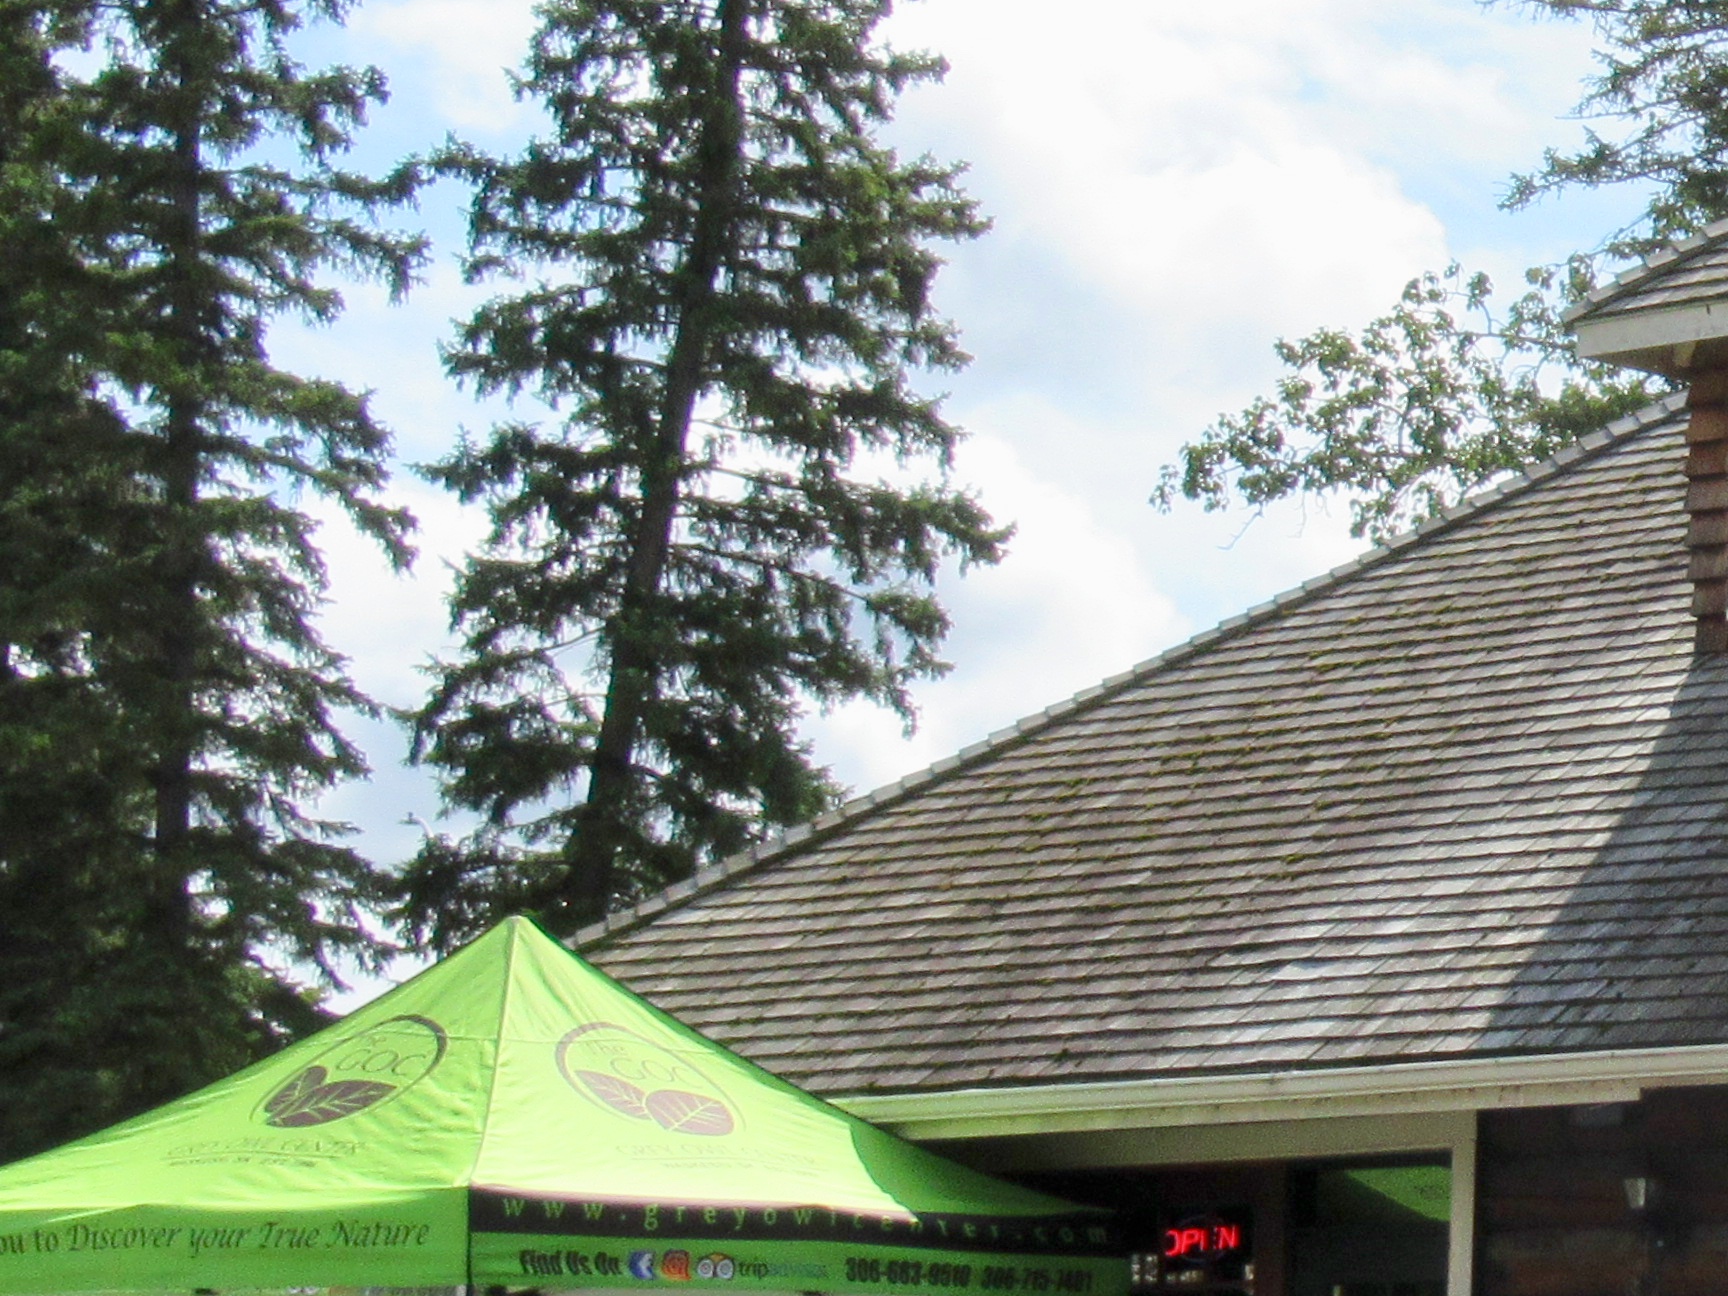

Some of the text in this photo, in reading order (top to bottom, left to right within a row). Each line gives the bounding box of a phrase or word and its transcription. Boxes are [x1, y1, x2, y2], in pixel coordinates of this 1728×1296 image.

[336, 1049, 428, 1077] GOC
[34, 1228, 60, 1252] to
[68, 1223, 182, 1252] Discover
[189, 1227, 250, 1258] your
[257, 1221, 320, 1249] True
[324, 1219, 430, 1248] Nature
[519, 1249, 564, 1276] Find
[566, 1251, 592, 1276] Us
